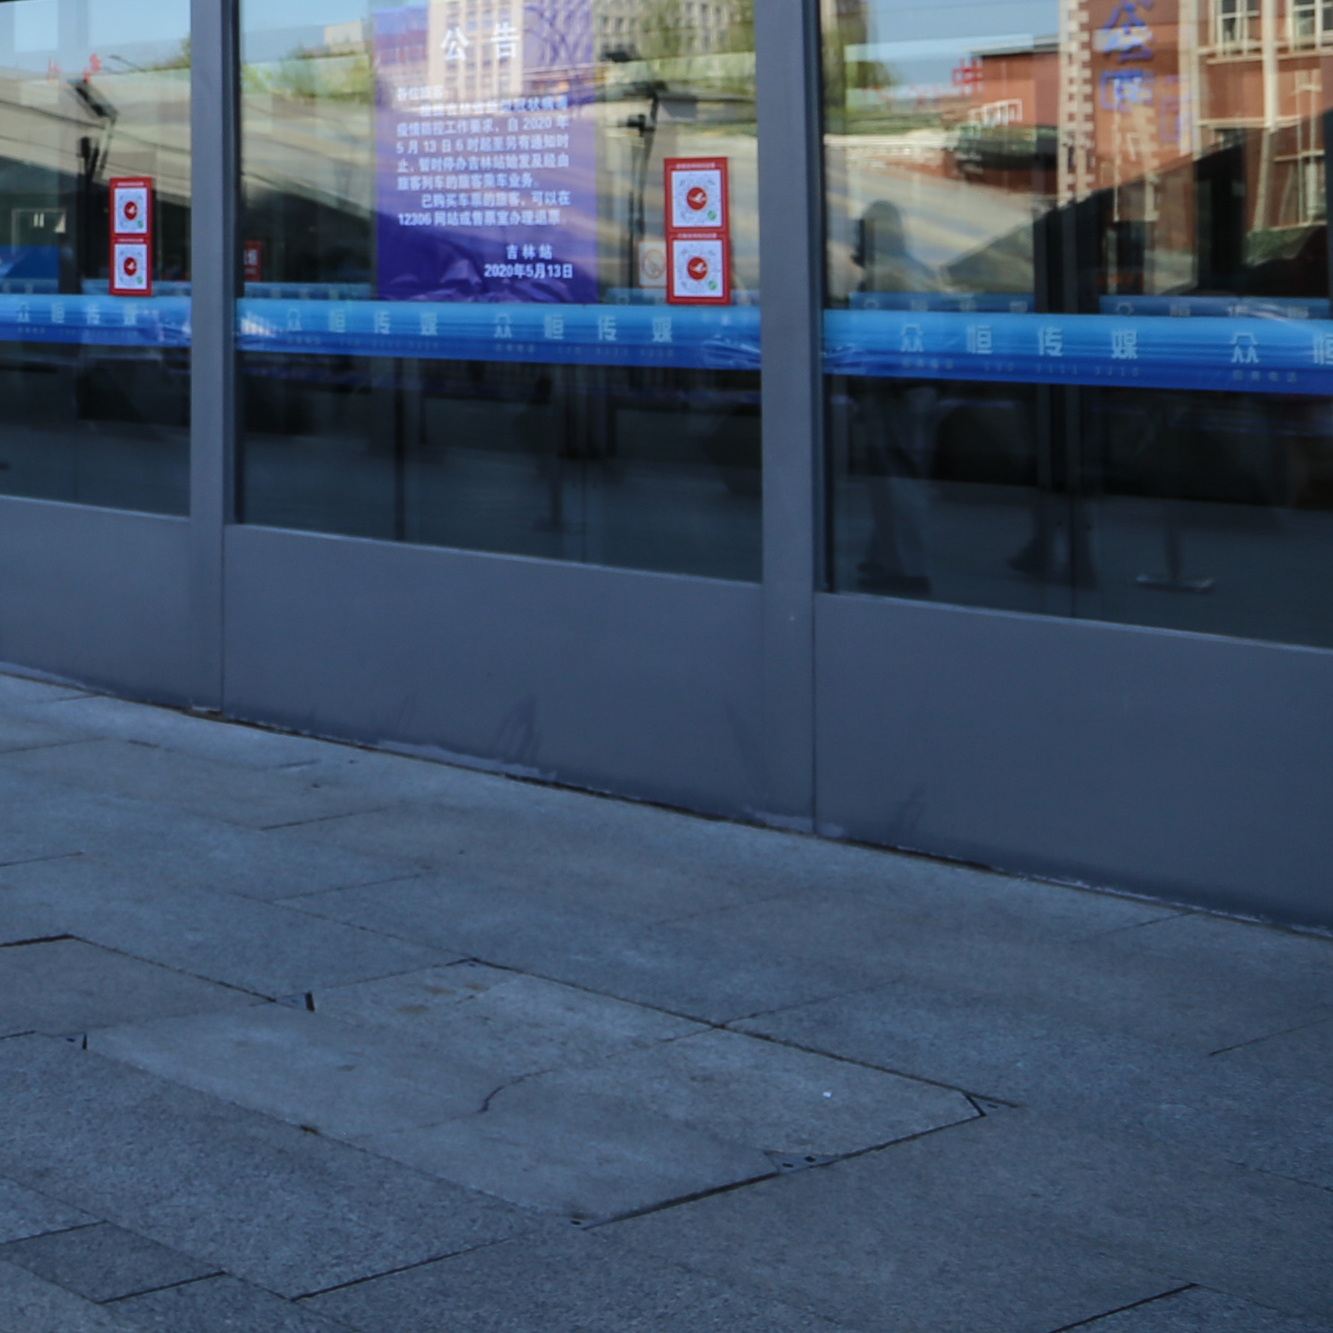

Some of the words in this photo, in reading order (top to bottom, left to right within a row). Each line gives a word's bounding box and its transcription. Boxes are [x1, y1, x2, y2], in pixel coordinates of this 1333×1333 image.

[441, 21, 521, 61] 公告
[506, 244, 553, 260] 吉林站
